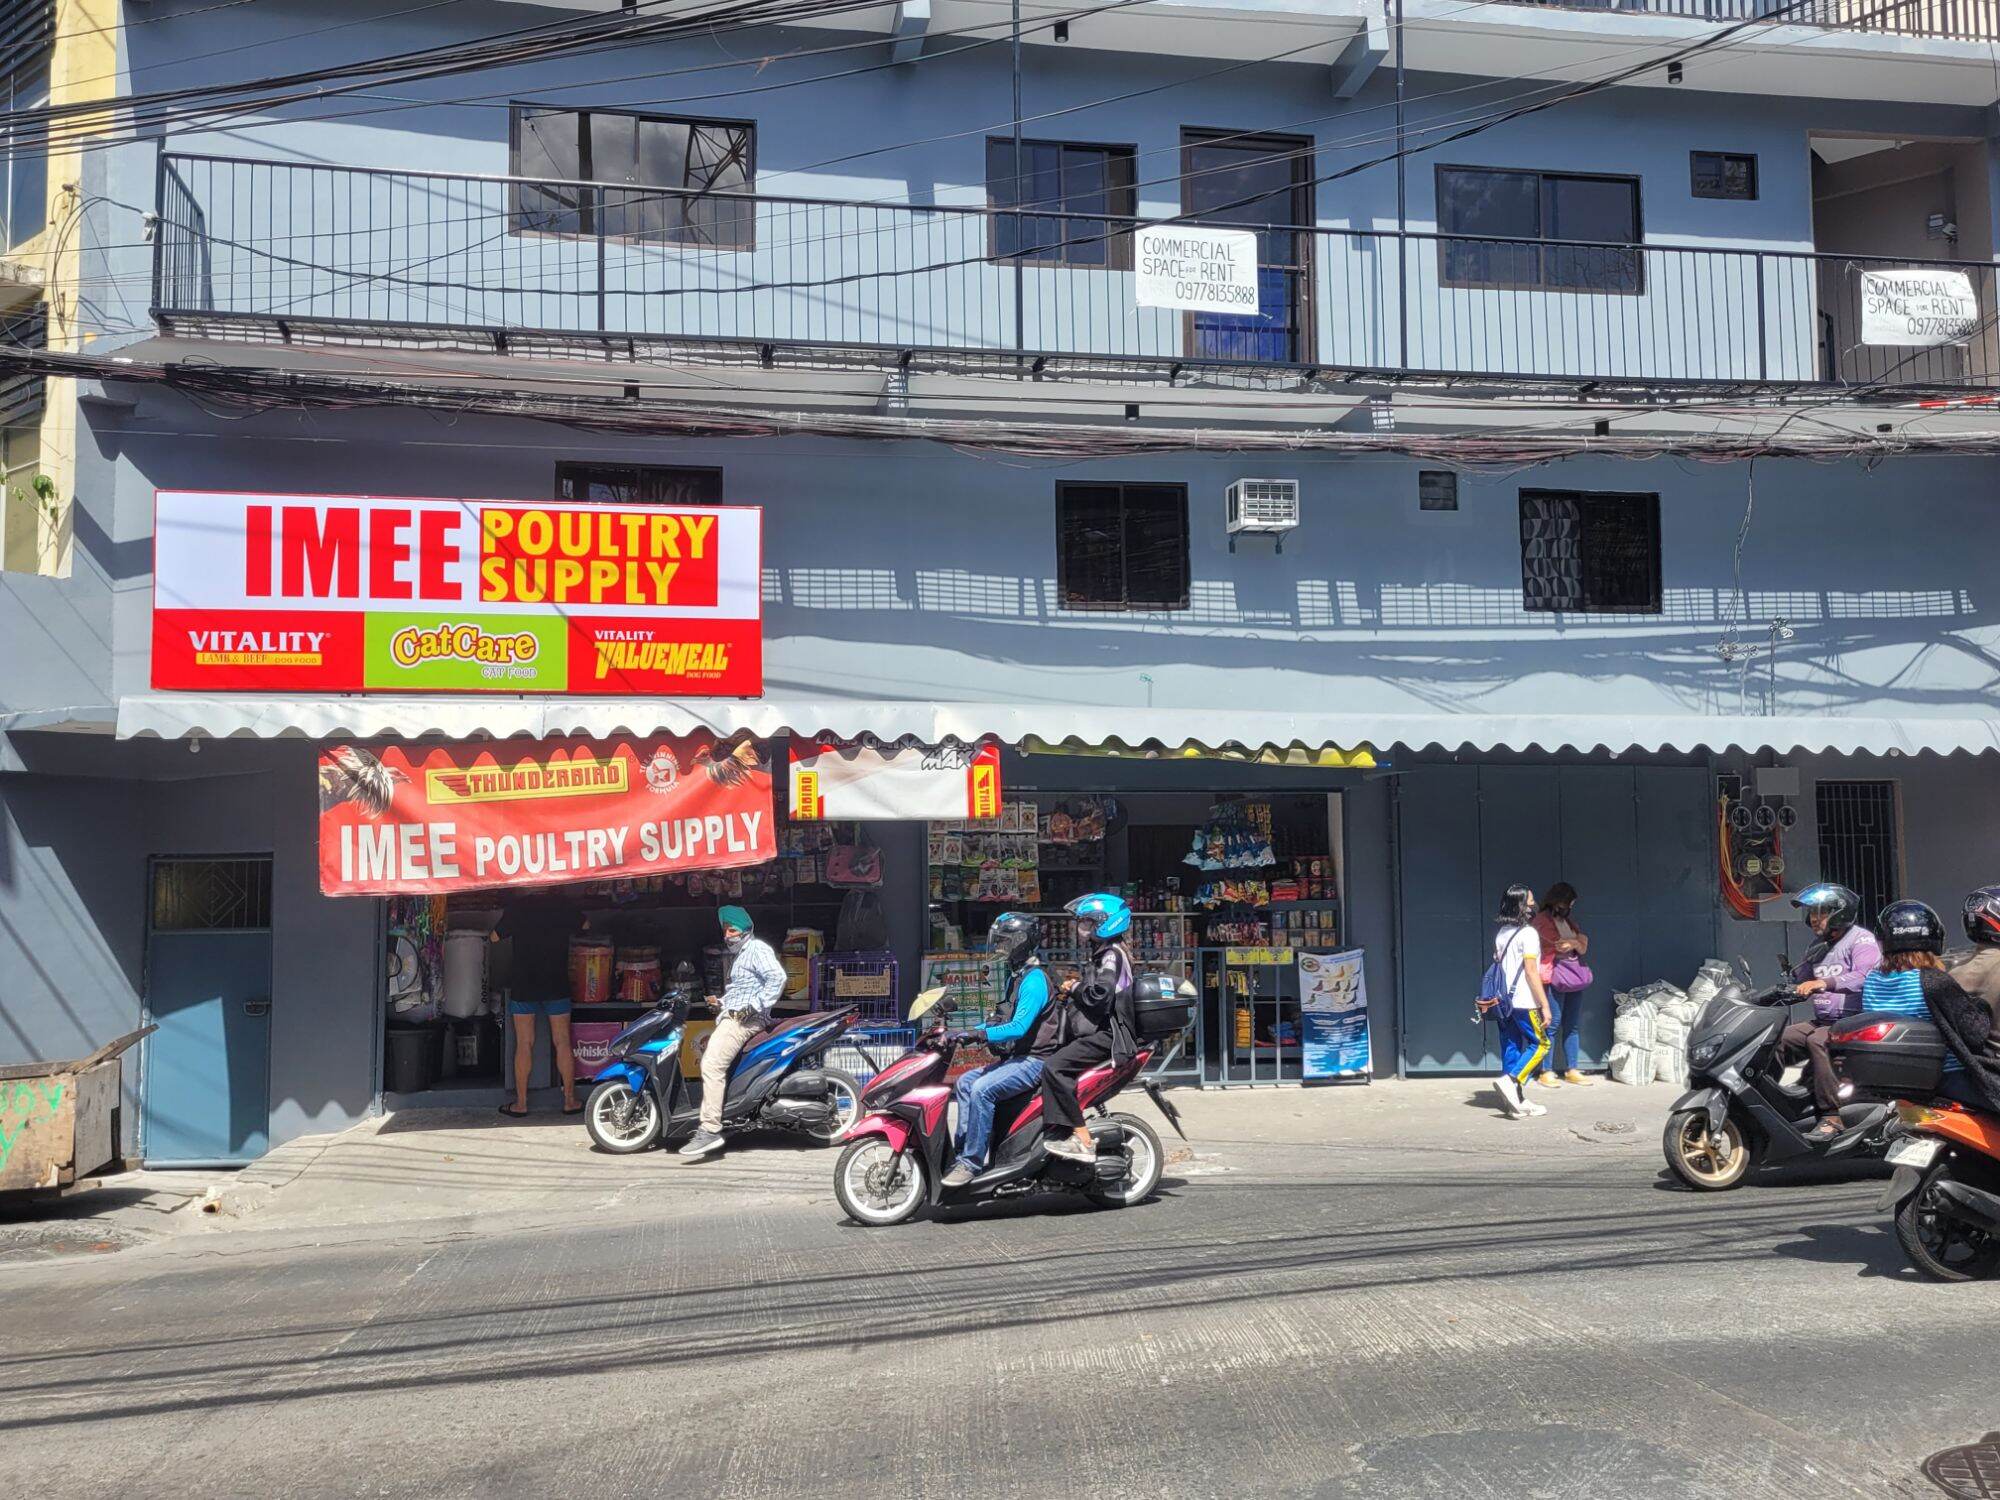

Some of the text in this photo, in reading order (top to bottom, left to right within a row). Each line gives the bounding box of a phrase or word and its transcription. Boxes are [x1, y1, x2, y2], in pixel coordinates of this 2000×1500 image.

[1143, 236, 1235, 262] COMMERCIAL
[1143, 258, 1185, 278] SPACE
[1200, 262, 1236, 281] RENT
[1176, 282, 1254, 304] 09778135888
[1866, 279, 1951, 297] COMMERCIAL
[1868, 298, 1911, 315] SPACE
[1931, 298, 1965, 315] RENT
[482, 510, 715, 559] POULTRY
[246, 505, 461, 600] IMEE
[480, 557, 680, 604] SUPPLY
[187, 631, 325, 652] VITALITY
[393, 625, 536, 666] CatCare
[594, 630, 654, 640] VITALITY
[202, 654, 230, 663] LAMB
[232, 654, 239, 663] &
[243, 654, 267, 663] BEEF
[594, 641, 728, 679] VALUEMEAL
[482, 667, 537, 679] CAT FOOD
[922, 748, 974, 770] MAX
[470, 764, 619, 793] THUNDERBIRD
[340, 811, 762, 882] IMEE POULTRY SUPPLY
[573, 1045, 613, 1057] whiska
